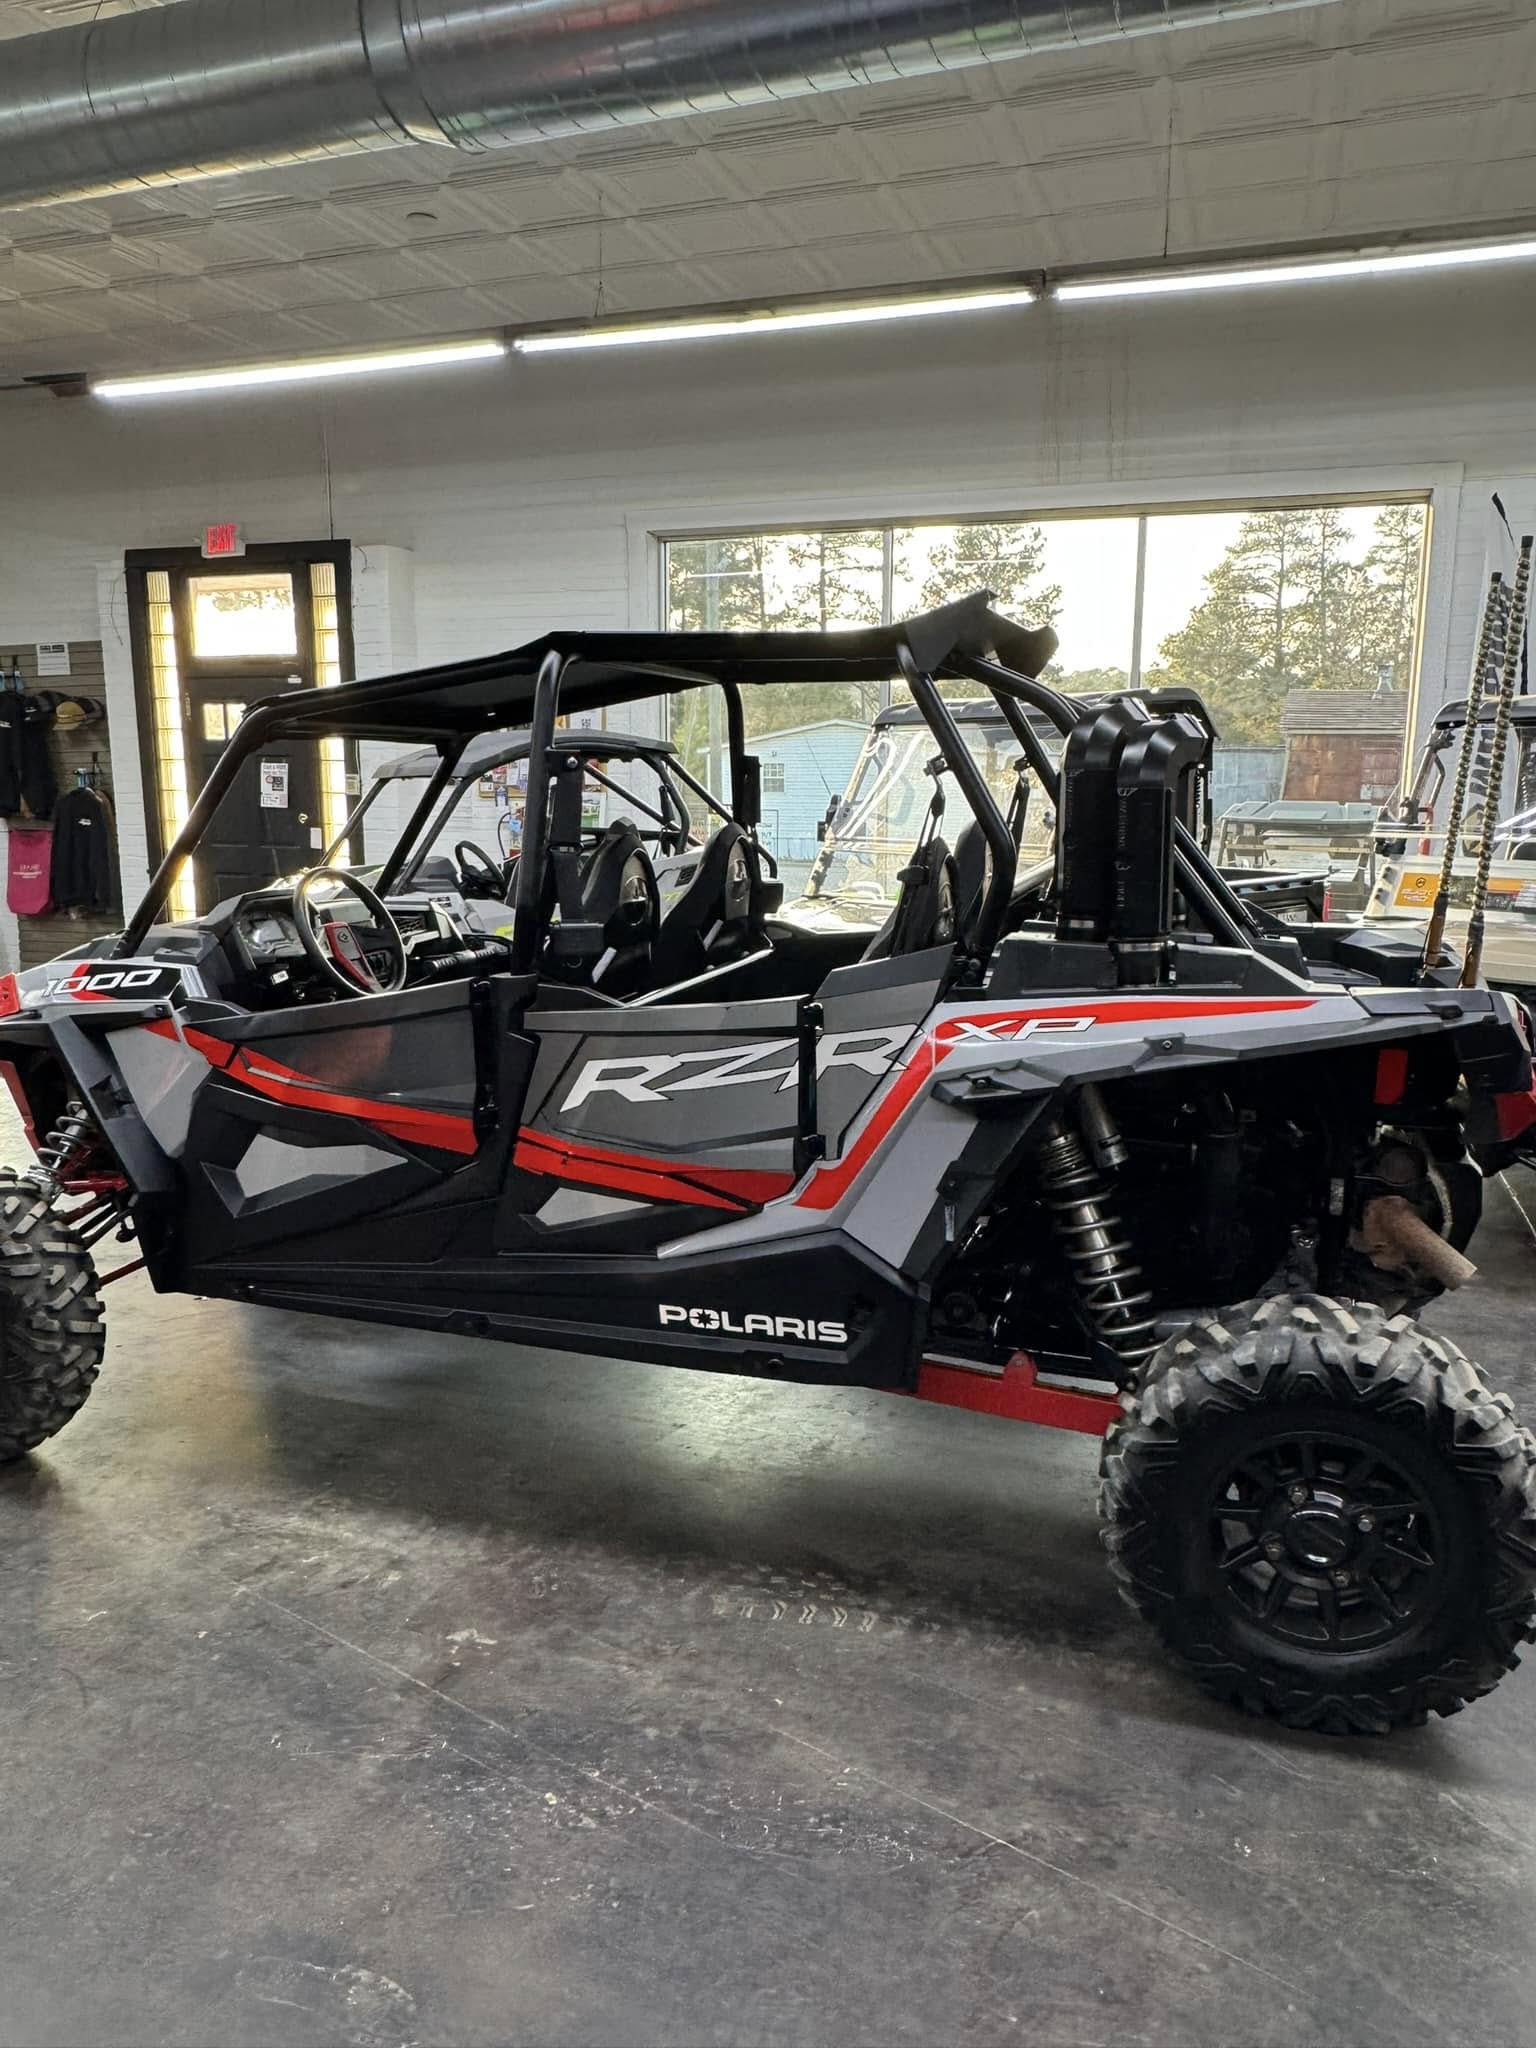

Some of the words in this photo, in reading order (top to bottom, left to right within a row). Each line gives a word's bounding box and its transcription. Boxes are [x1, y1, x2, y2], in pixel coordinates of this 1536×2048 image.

[207, 525, 236, 553] EXIT
[42, 969, 162, 996] 1000
[560, 1024, 923, 1113] RZR
[942, 1017, 1097, 1042] XP
[659, 1304, 848, 1343] POLARIS
